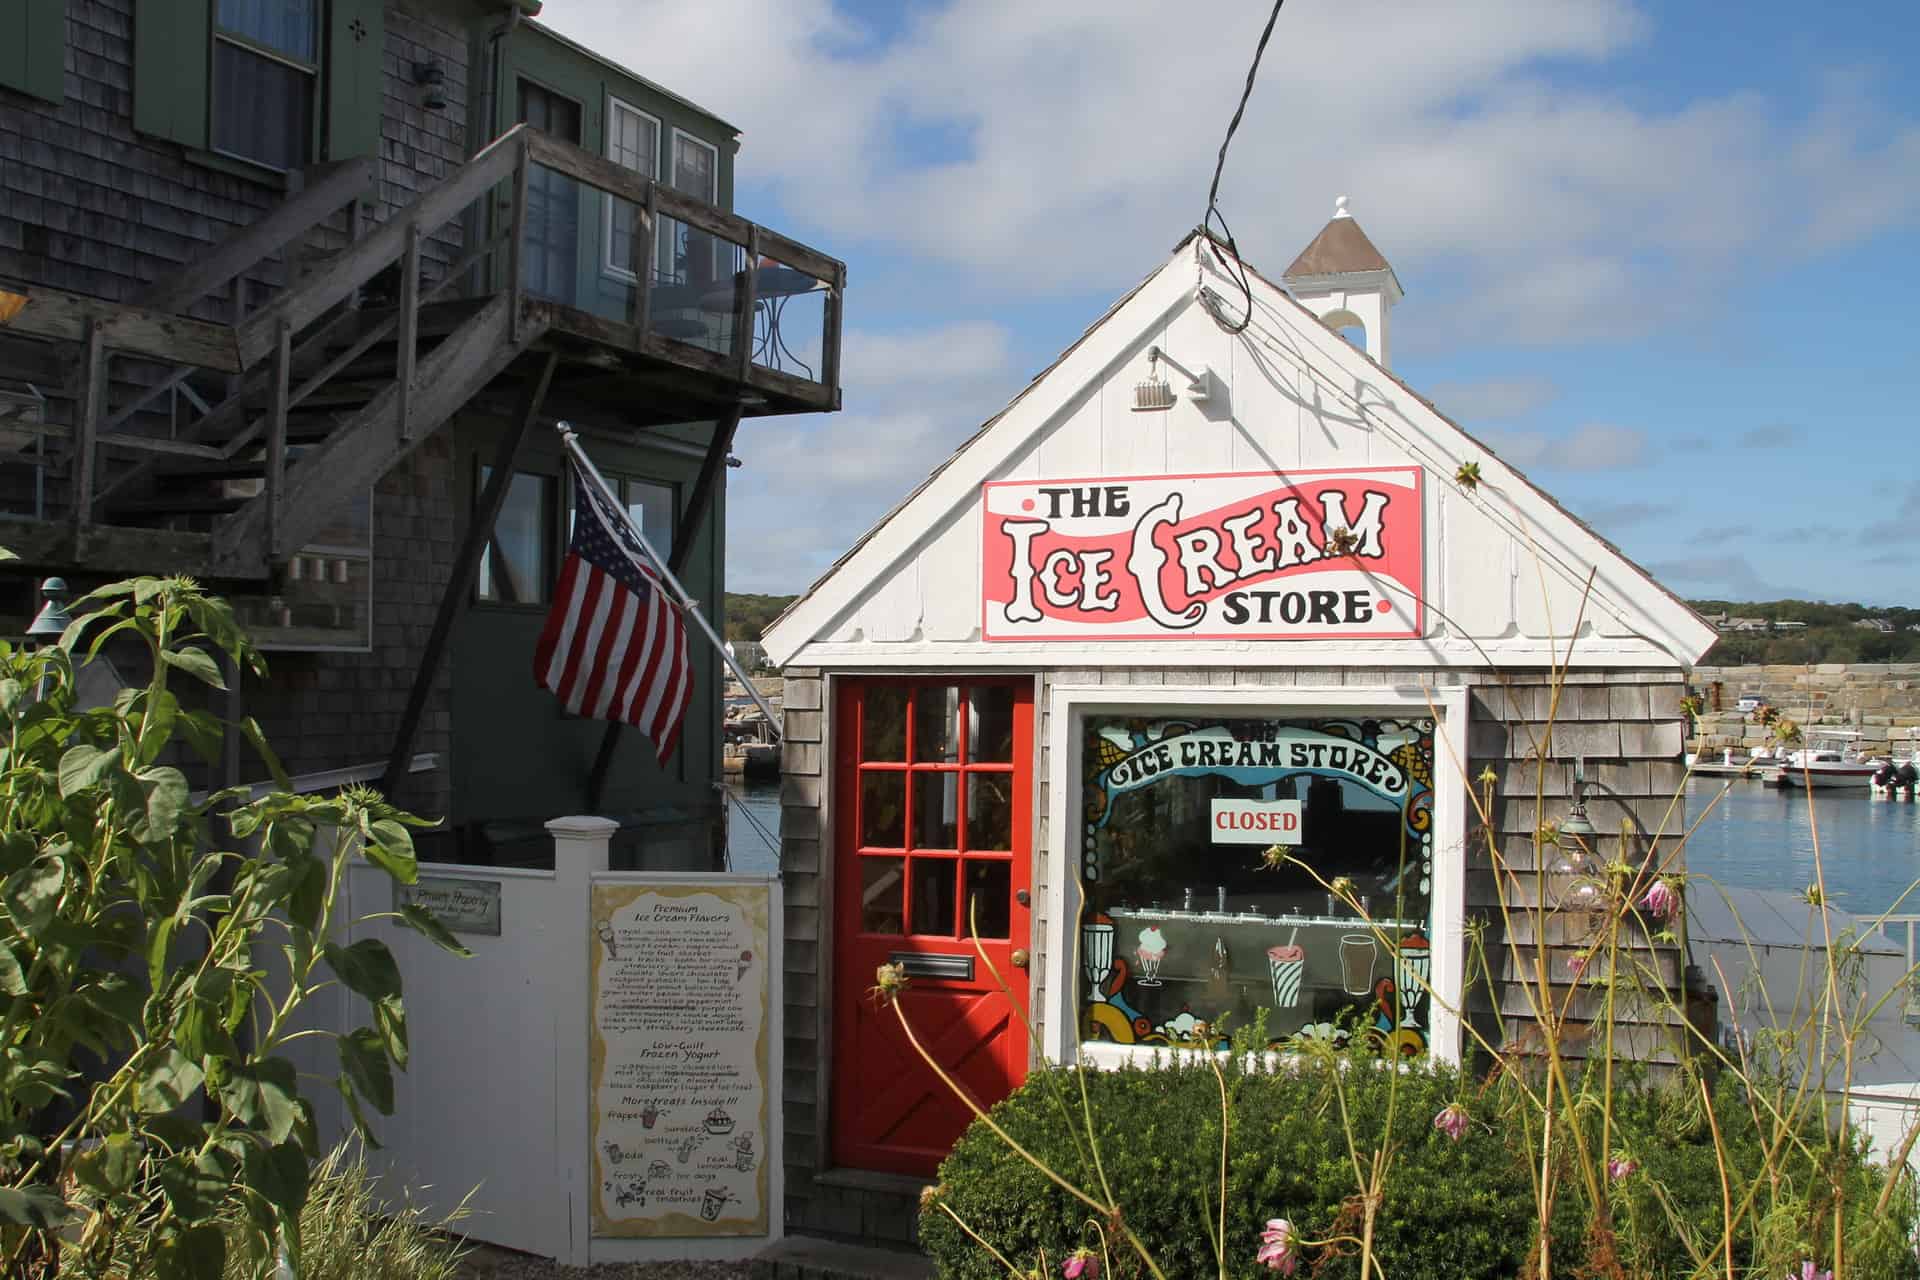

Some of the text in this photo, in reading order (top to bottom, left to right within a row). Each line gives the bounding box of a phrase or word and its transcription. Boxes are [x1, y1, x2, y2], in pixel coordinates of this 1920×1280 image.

[1038, 486, 1131, 519] THE
[1000, 489, 1391, 630] ICE CREAM
[1222, 589, 1373, 625] STORE
[1126, 742, 1392, 785] ICE CREAM STORE
[1215, 810, 1298, 832] CLOSED
[634, 913, 730, 923] Ice Cream Flavors
[652, 904, 699, 913] Premium
[640, 1049, 721, 1063] Frozen Yogurt
[621, 1096, 651, 1105] More
